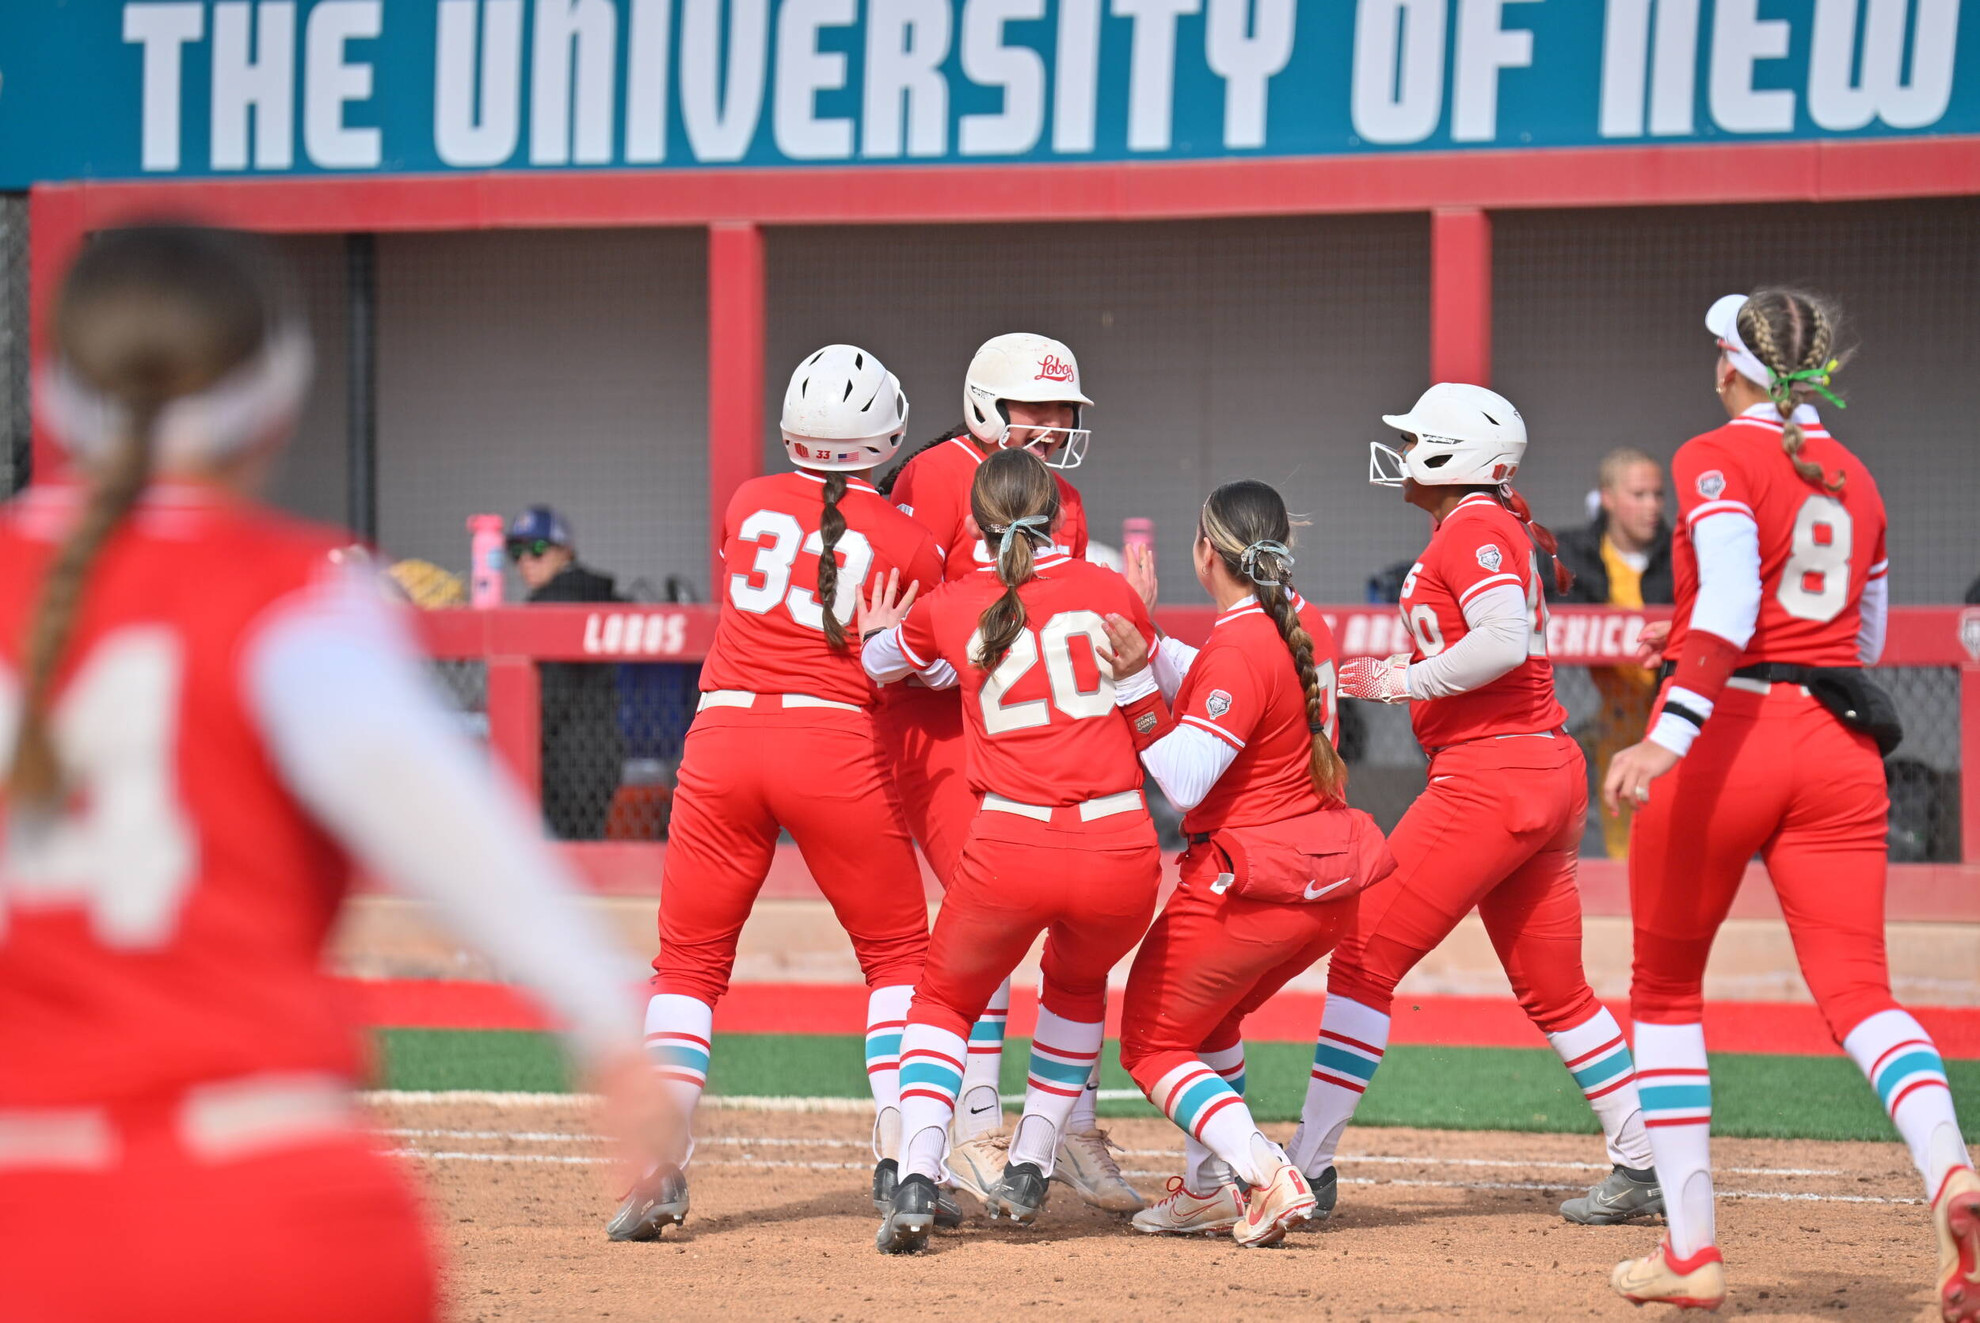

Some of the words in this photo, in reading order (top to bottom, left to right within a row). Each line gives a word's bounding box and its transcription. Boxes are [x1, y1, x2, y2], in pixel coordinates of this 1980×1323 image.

[123, 0, 383, 171] THE
[433, 0, 1296, 167] UNIVERSITY
[1350, 0, 1542, 145] OF
[1599, 0, 1960, 138] NEW
[1034, 354, 1075, 383] Lobos
[816, 449, 831, 459] 33
[729, 509, 875, 631] 33
[1777, 494, 1853, 622] 8
[583, 614, 687, 654] LOBOS
[966, 610, 1117, 735] 20
[1398, 604, 1446, 658] 0
[1546, 614, 1646, 657] EXICO
[0, 622, 202, 950] 4
